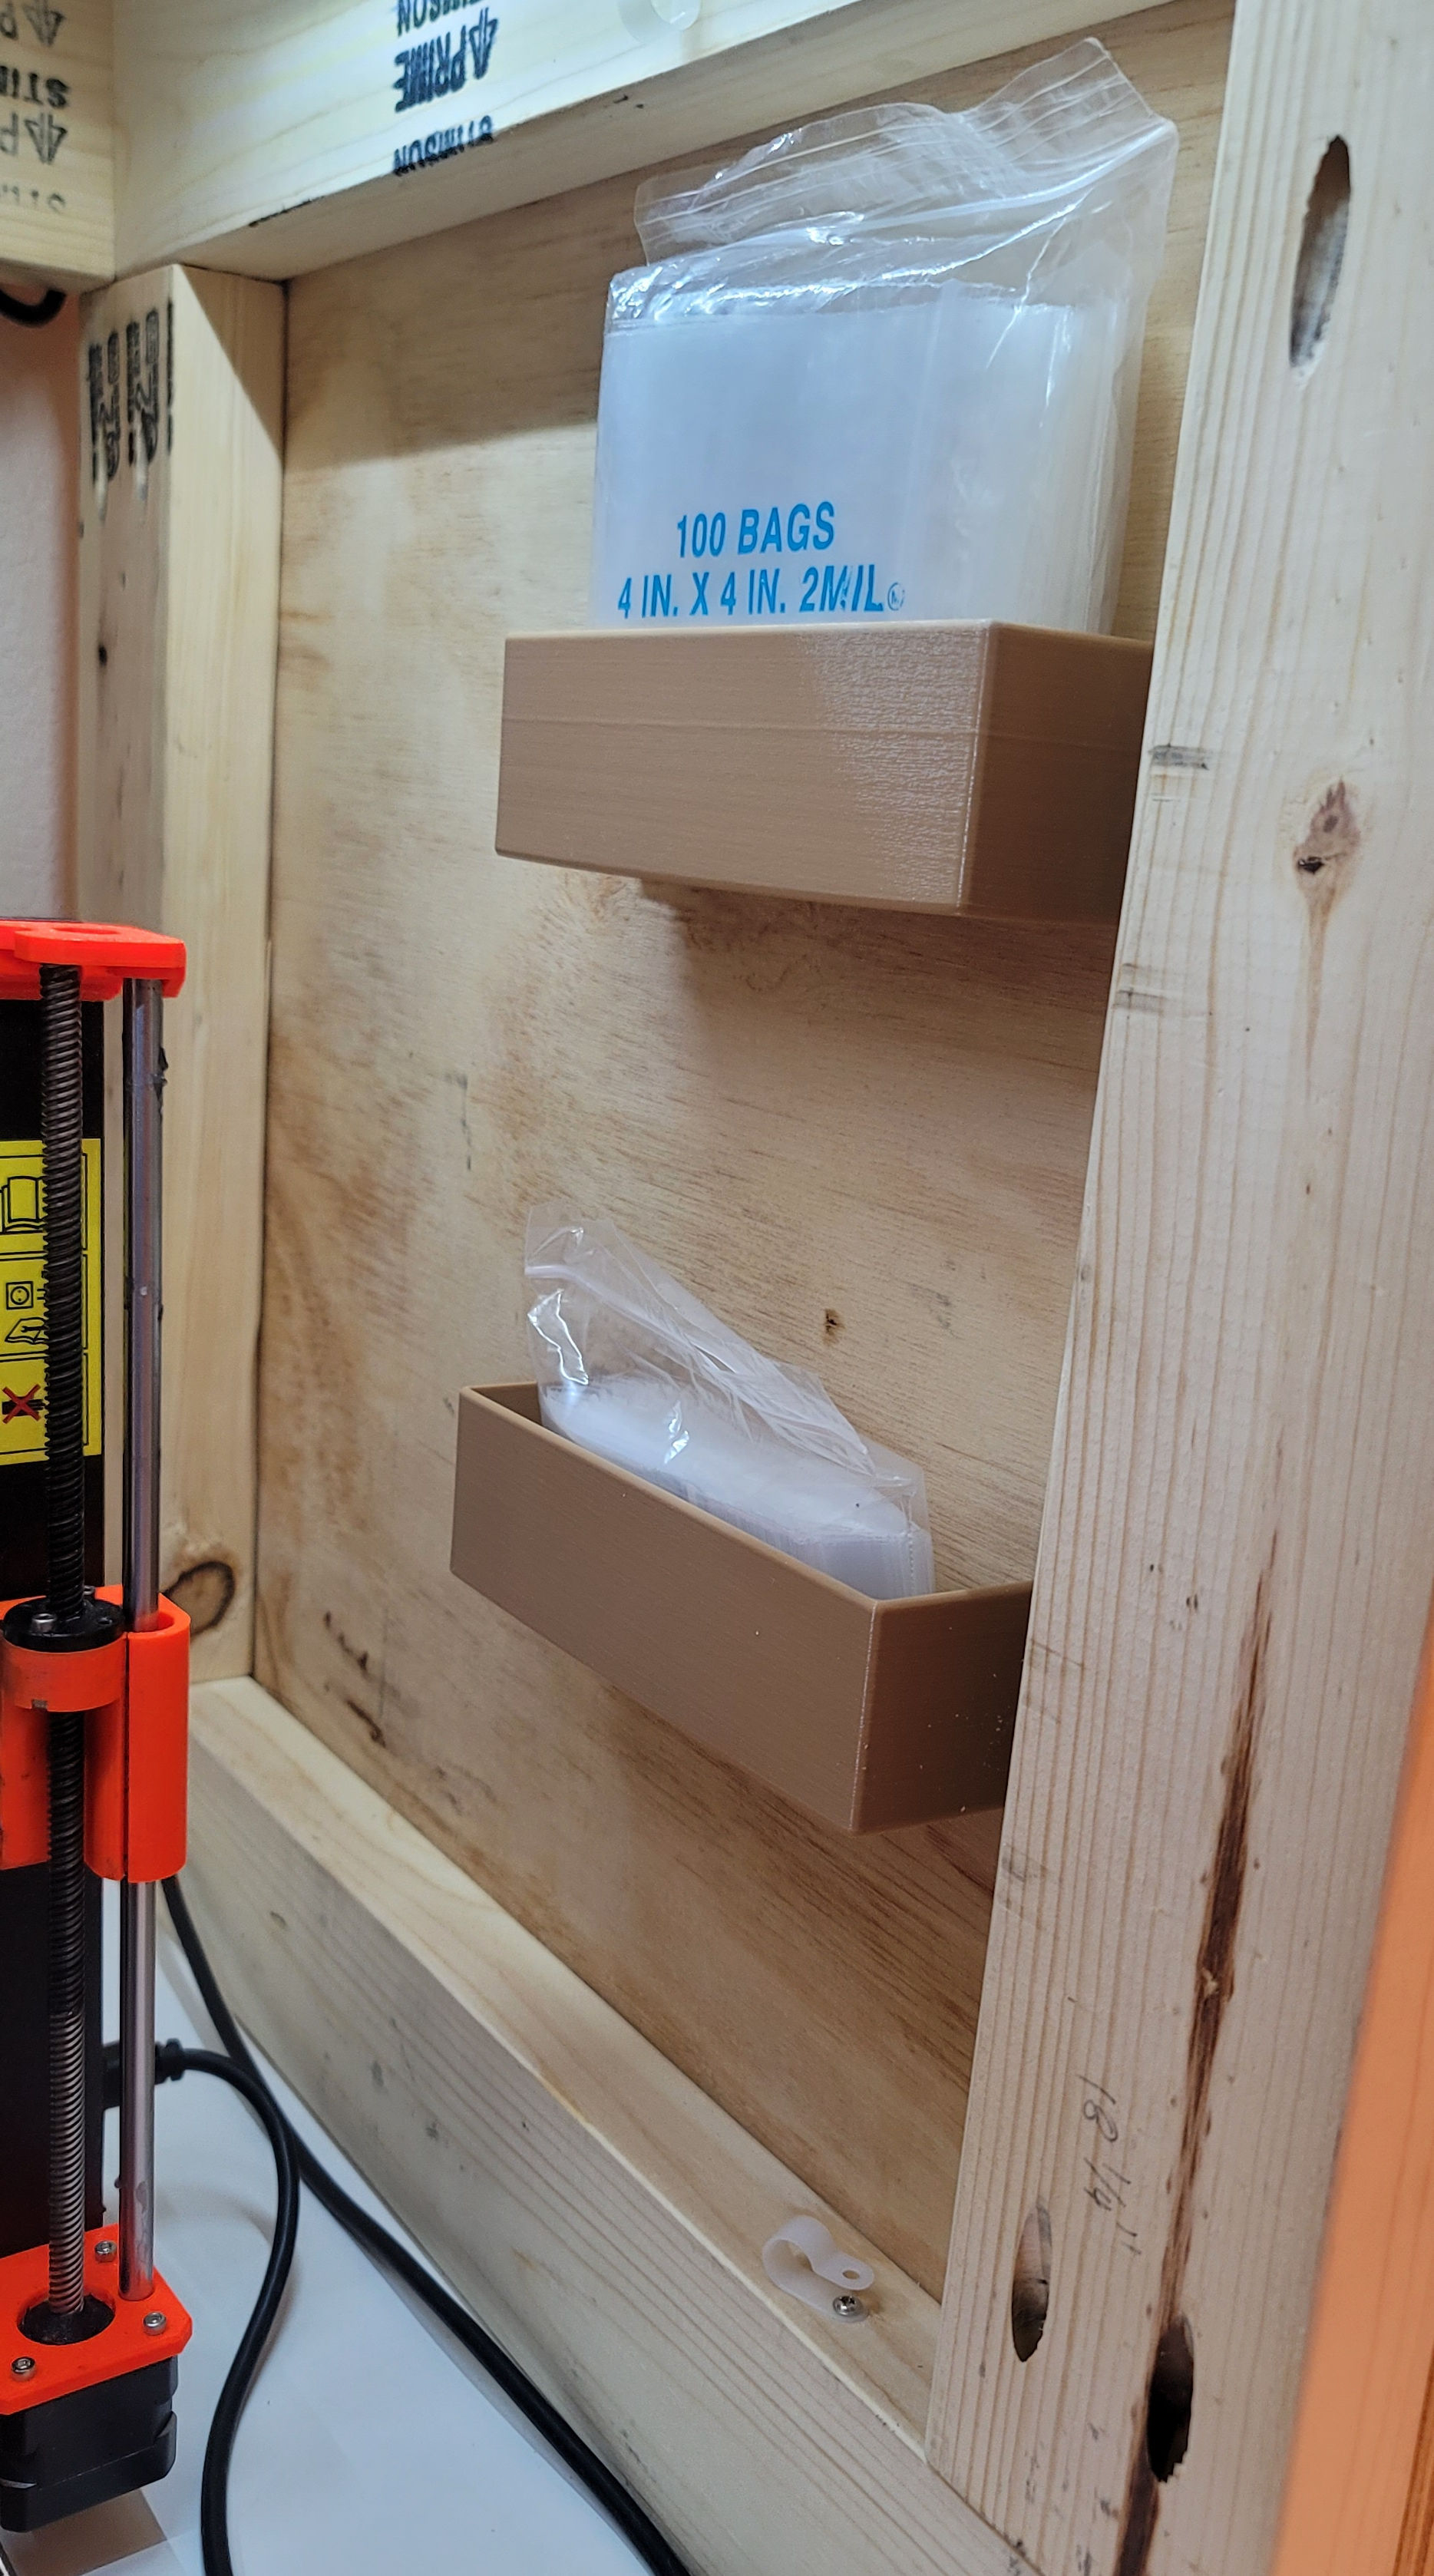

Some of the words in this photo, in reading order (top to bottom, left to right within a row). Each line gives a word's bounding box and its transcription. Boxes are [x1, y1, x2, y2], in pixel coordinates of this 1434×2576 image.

[392, 25, 467, 113] PRIME
[677, 513, 726, 558] 100
[738, 501, 834, 555] BAGS
[617, 577, 632, 618] 4
[642, 574, 678, 618] IN.
[689, 572, 709, 616] X
[720, 571, 736, 615] 4
[748, 568, 785, 614] IN.
